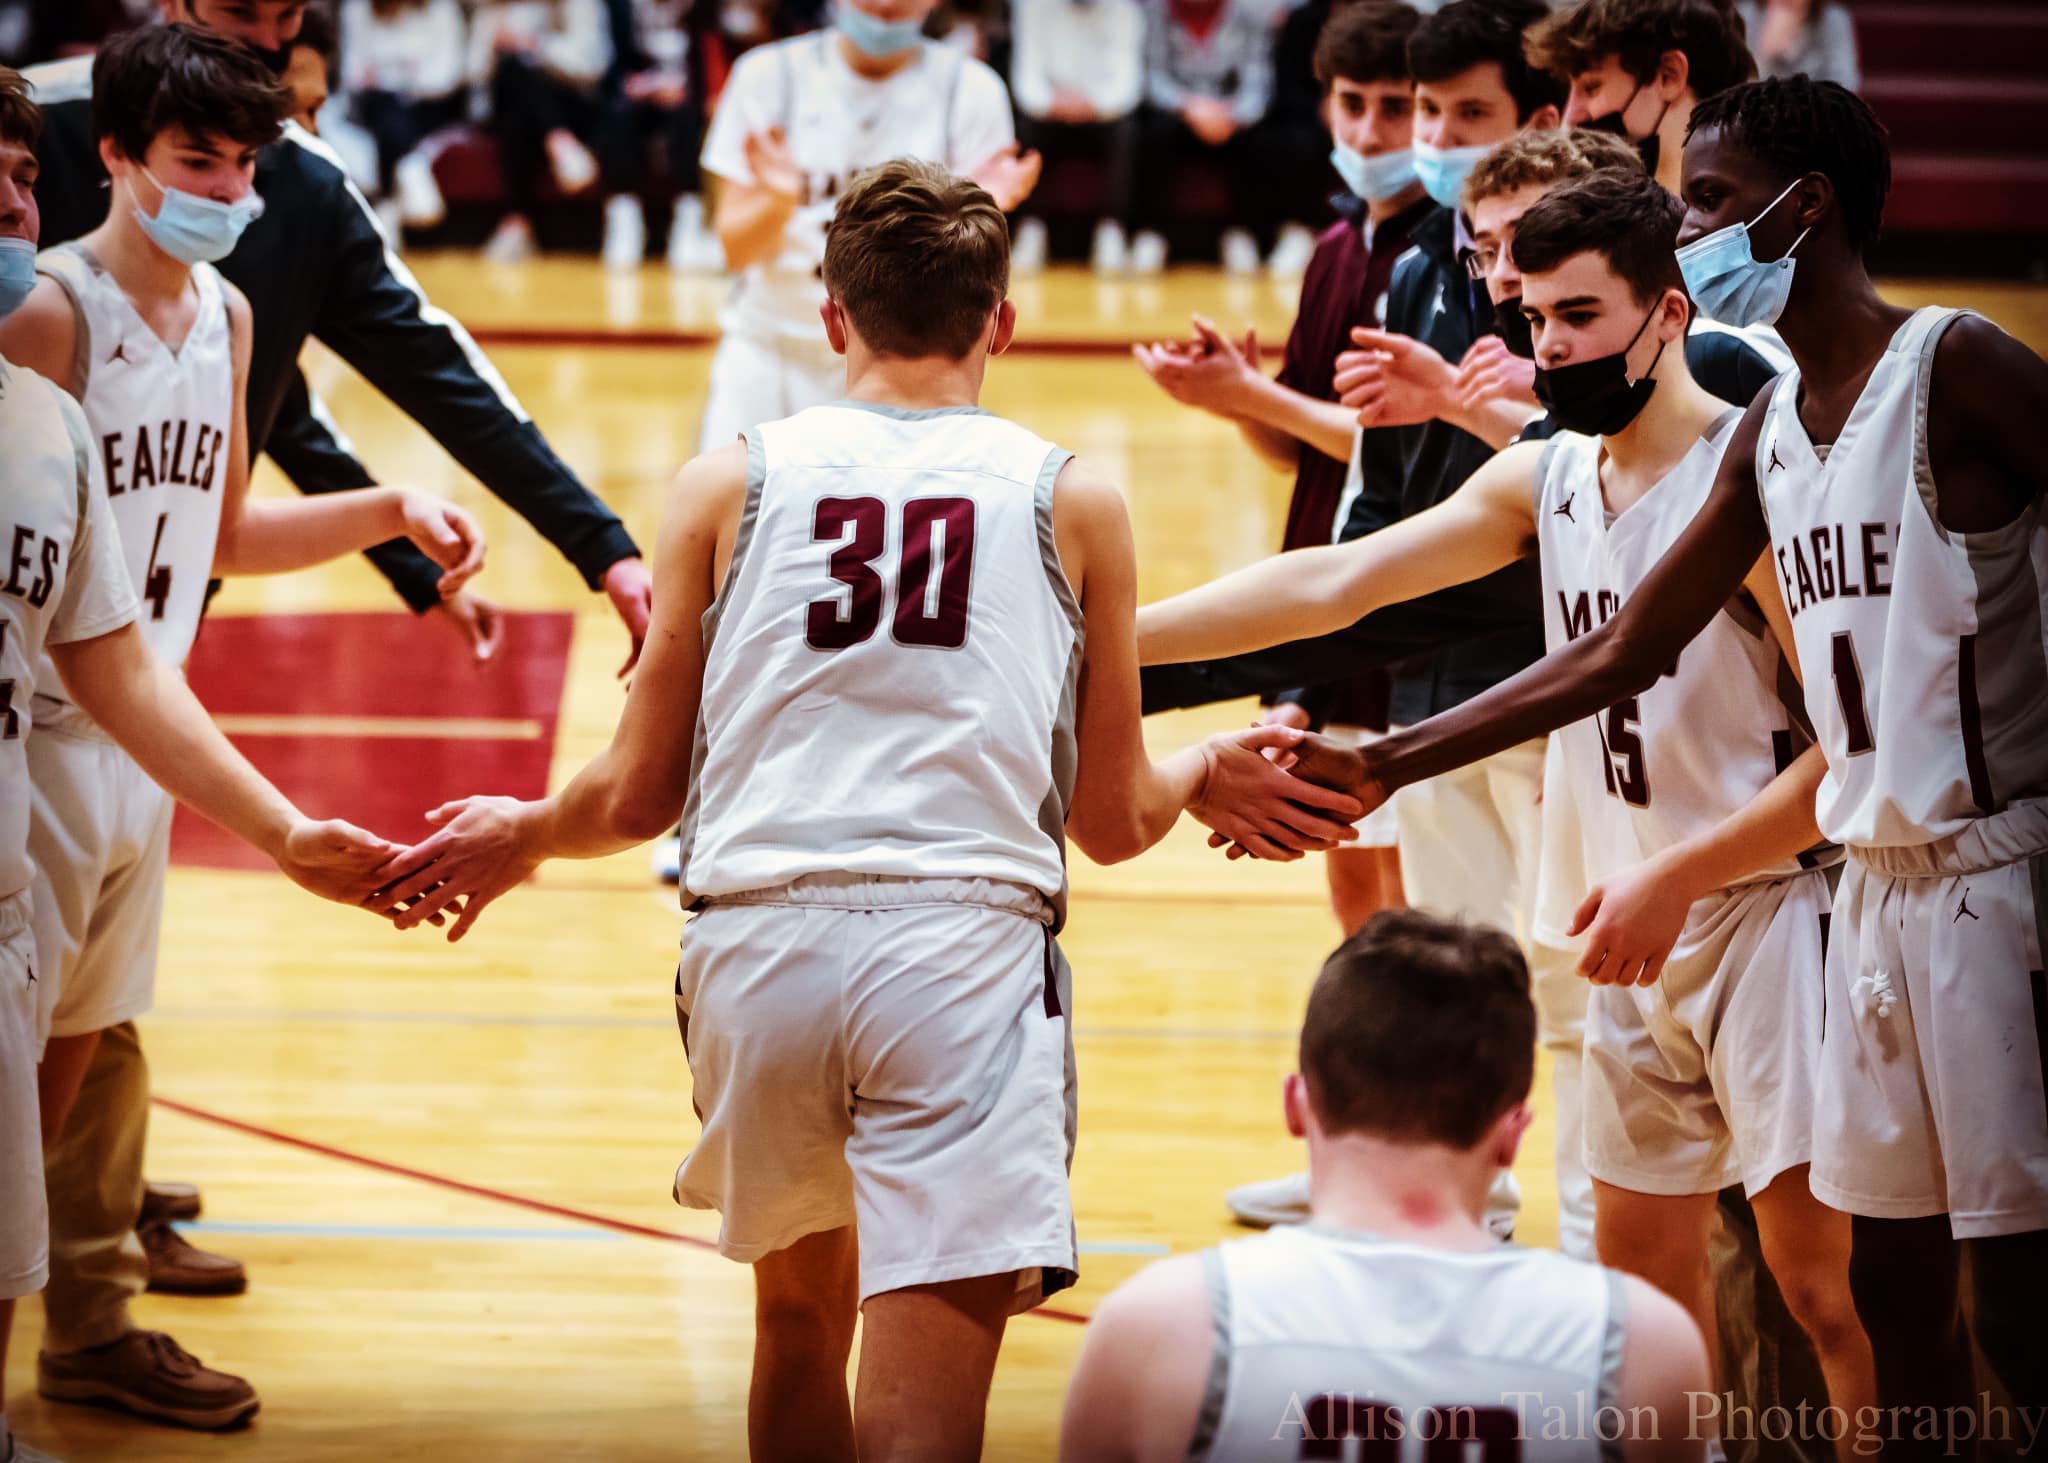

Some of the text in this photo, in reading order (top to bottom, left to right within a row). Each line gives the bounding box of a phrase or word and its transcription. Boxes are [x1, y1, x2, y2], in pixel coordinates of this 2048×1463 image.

[102, 419, 223, 498] EAGLES
[0, 523, 59, 609] ES
[143, 511, 172, 620] 4
[803, 493, 979, 652] 30
[1777, 521, 1901, 619] EAGLE
[1830, 629, 1876, 758] 1
